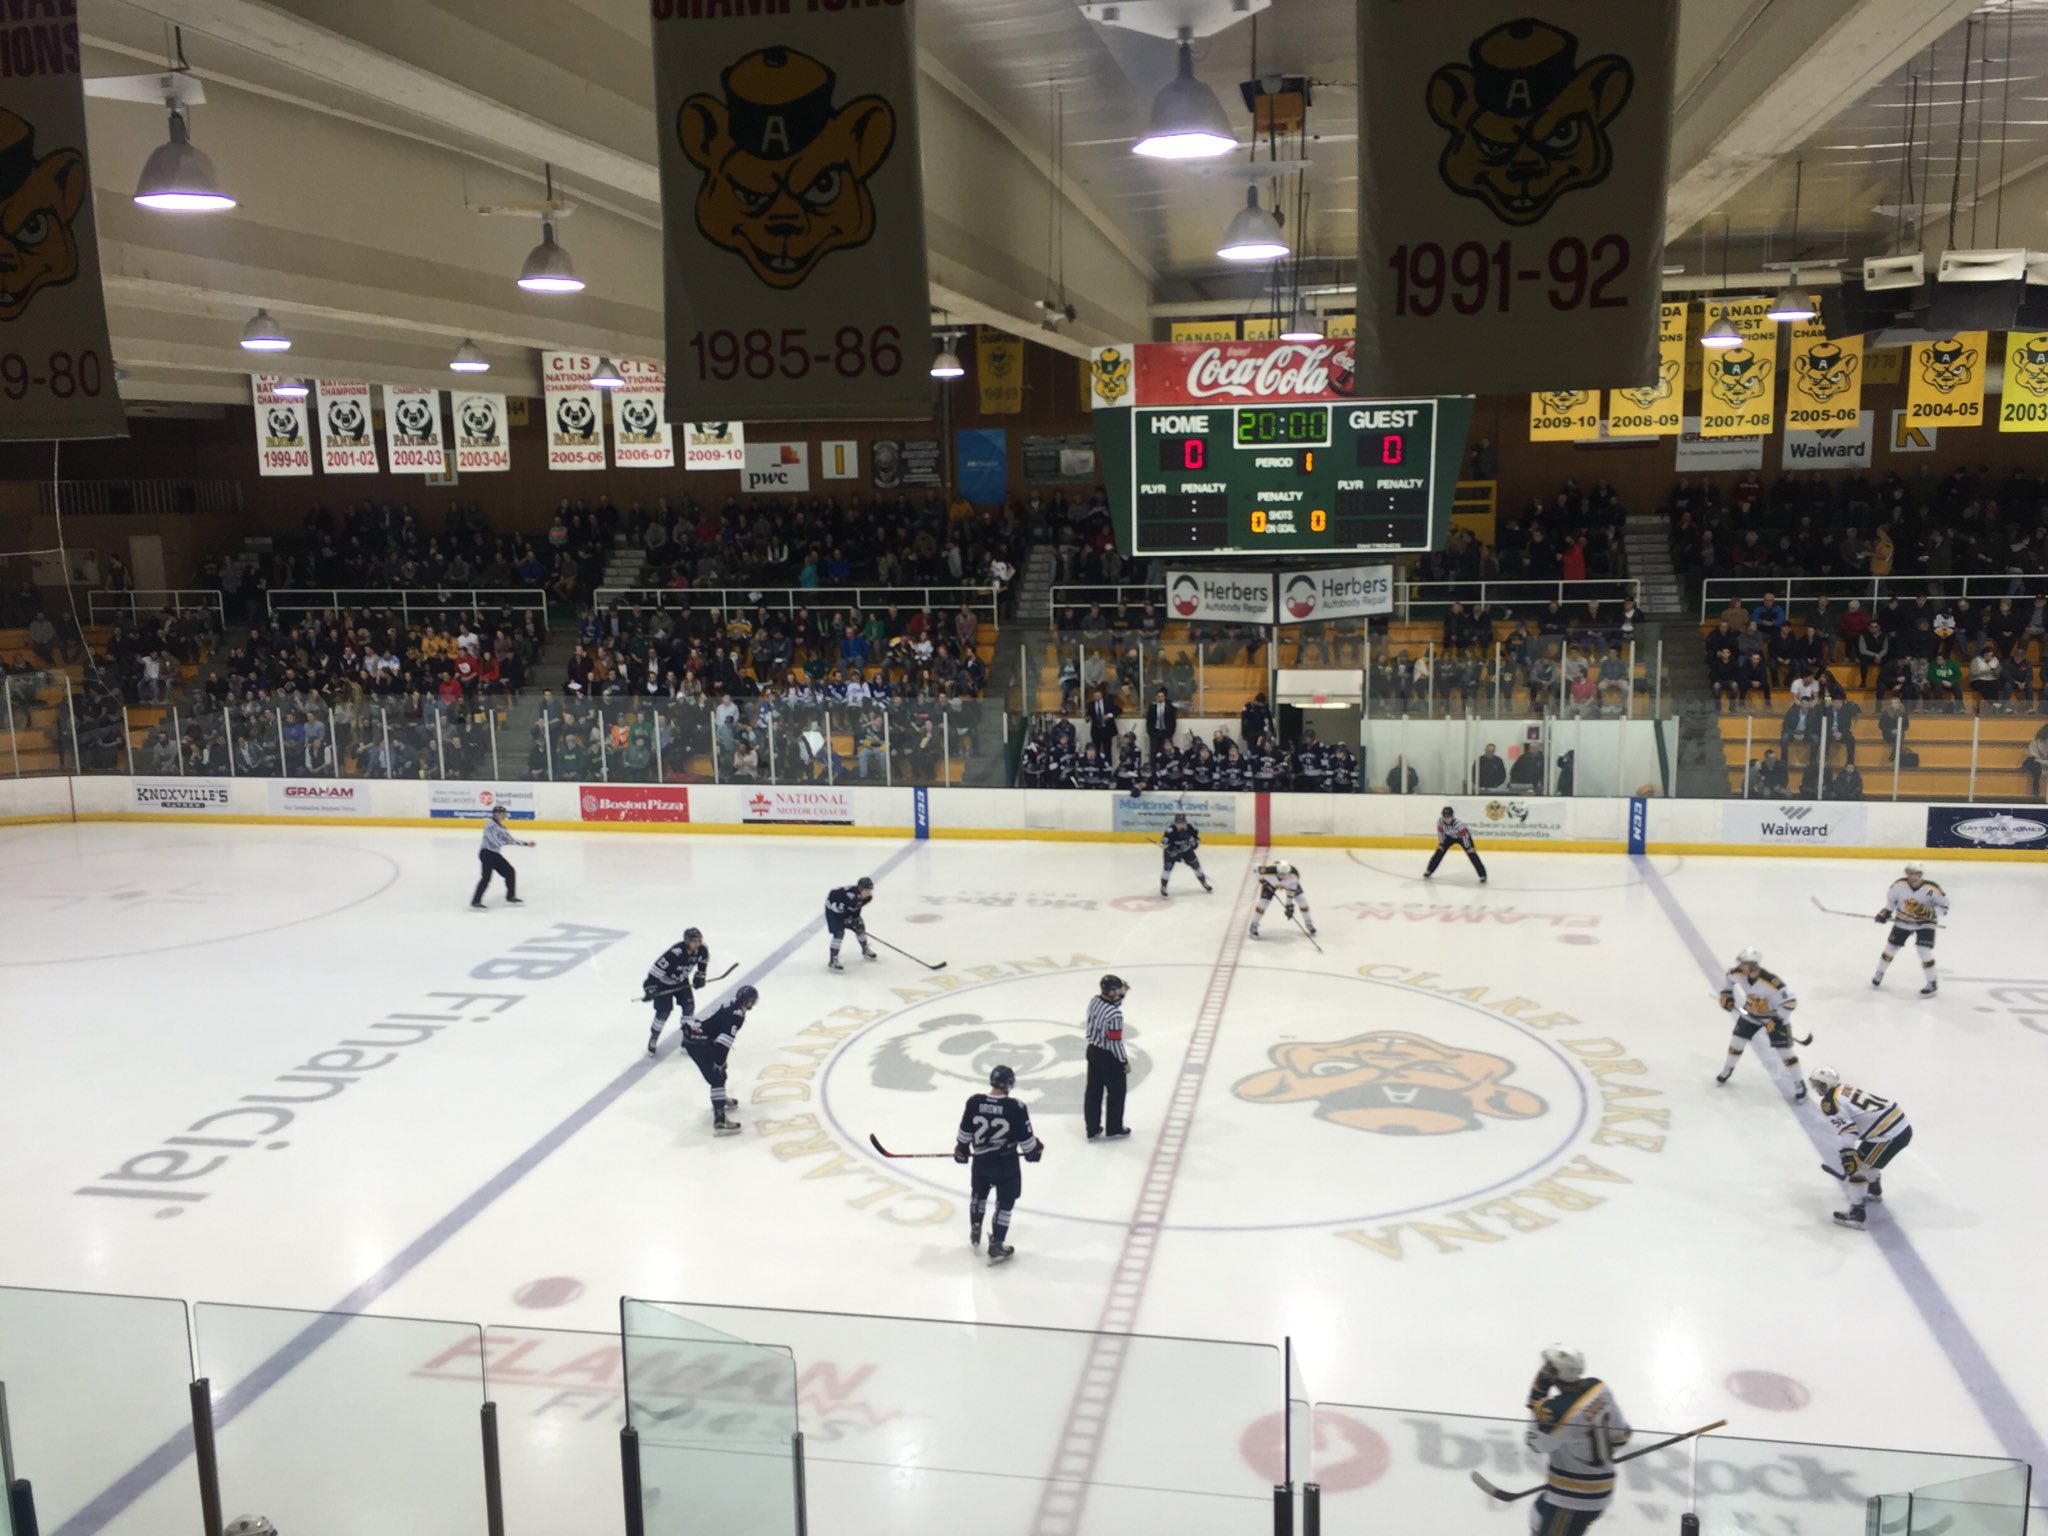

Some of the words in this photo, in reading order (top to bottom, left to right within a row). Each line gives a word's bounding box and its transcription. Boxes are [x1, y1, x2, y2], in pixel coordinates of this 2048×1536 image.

[1389, 233, 1631, 317] 1991-92
[689, 325, 903, 381] 1985-86
[1186, 344, 1335, 398] Coca-Cola
[1790, 409, 1857, 422] 2005-06
[1912, 403, 1979, 417] 2004-05
[1151, 415, 1209, 434] HOME
[1238, 411, 1327, 440] 20:00
[1349, 410, 1419, 430] GUEST
[1533, 416, 1597, 429] 2009-10
[1612, 414, 1680, 428] 2008-09
[1704, 414, 1770, 428] 2007-08
[394, 450, 442, 466] 2002-03
[551, 451, 604, 463] 2005-06
[617, 449, 671, 461] 2006-07
[687, 449, 742, 462] 2009-10
[1184, 439, 1203, 470] 0
[1382, 435, 1402, 465] 0
[1790, 441, 1866, 459] Waiward
[264, 450, 309, 468] 1999-00
[327, 450, 375, 467] 2001-02
[459, 451, 508, 467] 2003-04
[749, 469, 788, 488] pwc
[1376, 478, 1424, 490] PENALTY
[1180, 482, 1227, 493] PENALTY
[1257, 491, 1304, 502] PENALTY
[1203, 581, 1268, 602] Herbers
[1322, 577, 1388, 598] Herbers
[1204, 602, 1241, 613] Autobody
[1242, 603, 1268, 614] Repair
[136, 788, 229, 803] KNOXVILLE'S
[285, 786, 354, 798] GRAHAM
[776, 793, 848, 805] NATIONAL
[777, 807, 812, 816] MOTOR
[813, 807, 848, 816] COACH
[1760, 822, 1828, 836] Waiward
[73, 991, 528, 1220] Financial
[972, 1115, 1010, 1145] 22
